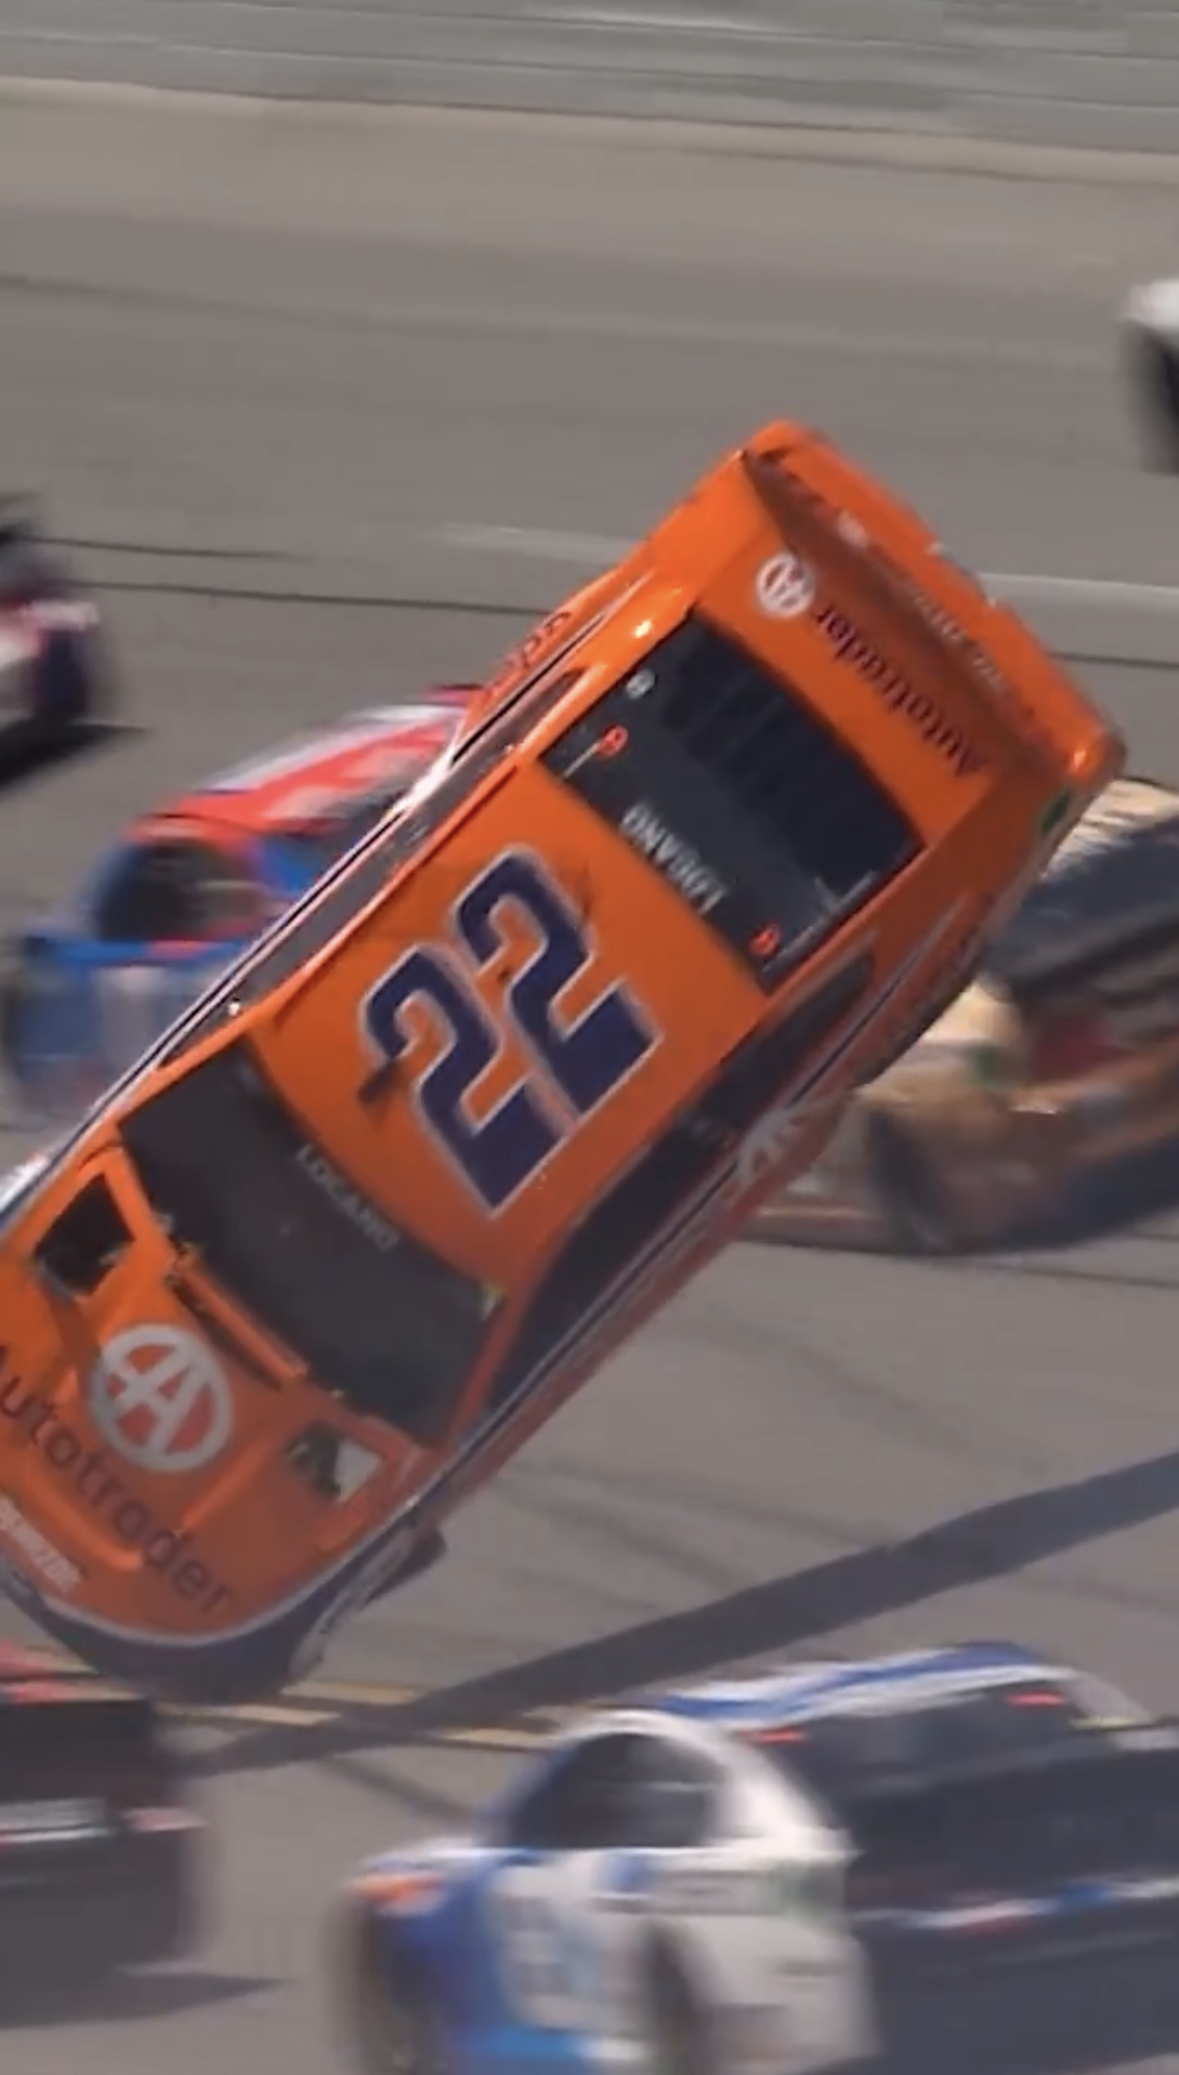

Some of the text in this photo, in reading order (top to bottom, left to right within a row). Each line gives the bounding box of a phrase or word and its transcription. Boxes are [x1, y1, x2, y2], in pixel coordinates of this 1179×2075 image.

[815, 604, 992, 777] Autotrader
[619, 800, 728, 914] LOGANO
[358, 843, 664, 1219] 22
[295, 1142, 399, 1251] LOGANO
[0, 1345, 233, 1616] utotrader
